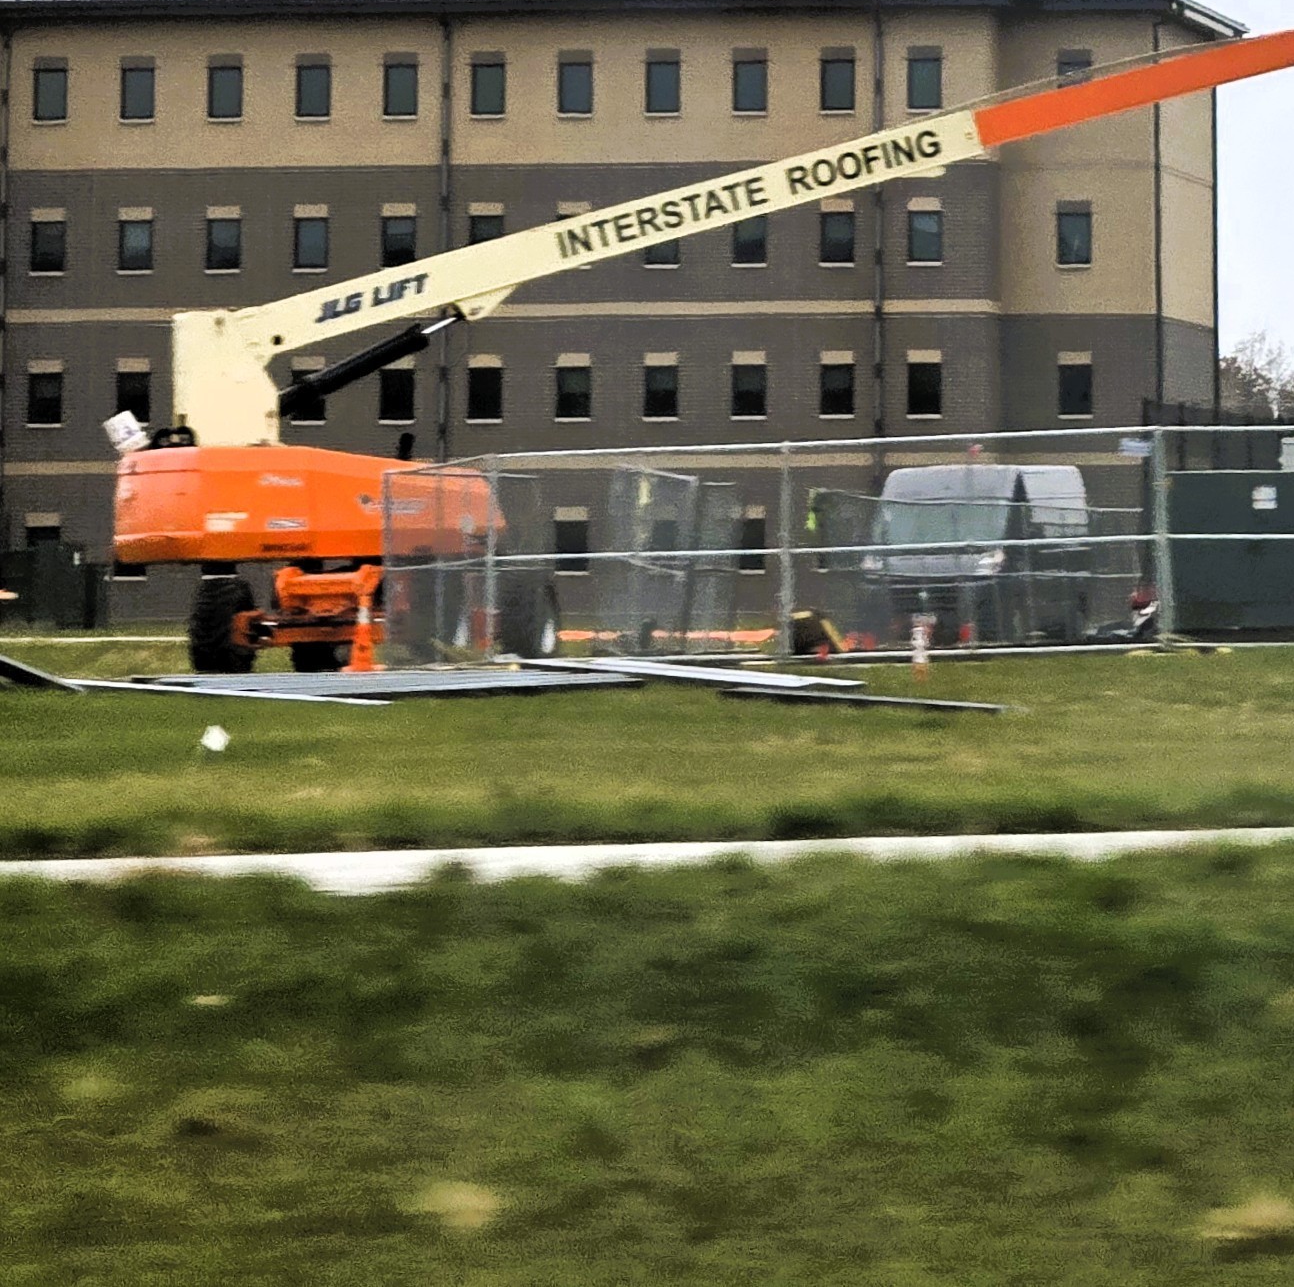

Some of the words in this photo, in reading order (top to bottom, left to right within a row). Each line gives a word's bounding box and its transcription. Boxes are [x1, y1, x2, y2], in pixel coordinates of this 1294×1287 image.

[555, 176, 769, 259] INTERSTATE
[785, 130, 942, 195] ROOFING
[315, 292, 364, 323] JLG
[371, 273, 429, 308] LIFT
